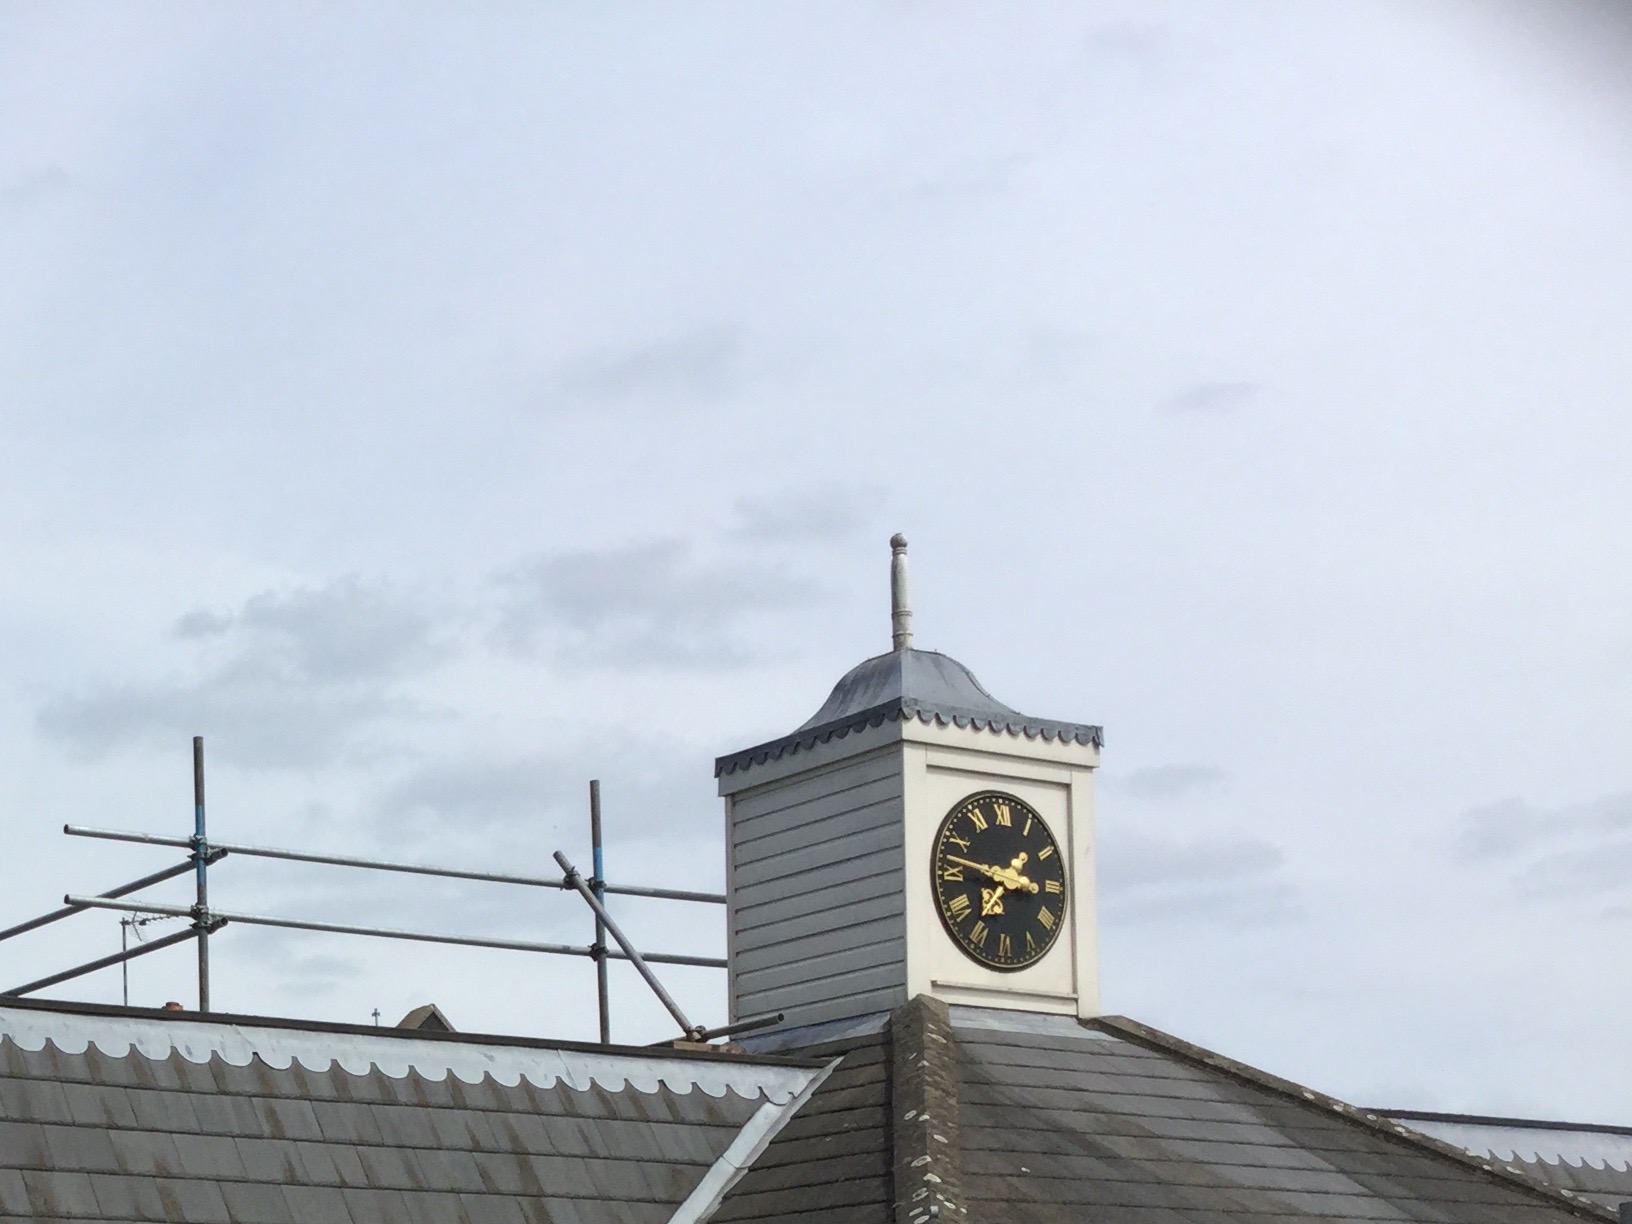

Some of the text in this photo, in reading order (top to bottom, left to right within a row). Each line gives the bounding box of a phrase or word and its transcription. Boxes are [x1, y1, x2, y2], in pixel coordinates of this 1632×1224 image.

[968, 808, 989, 833] XI
[993, 804, 1012, 827] XII
[1023, 817, 1032, 837] I
[949, 831, 970, 853] X
[1038, 845, 1053, 861] II
[944, 864, 963, 882] IX
[1045, 879, 1060, 894] III
[949, 894, 972, 922] VIII
[1037, 906, 1055, 930] IIII
[970, 920, 989, 948] VII
[1026, 931, 1036, 951] V
[999, 934, 1011, 957] VI
